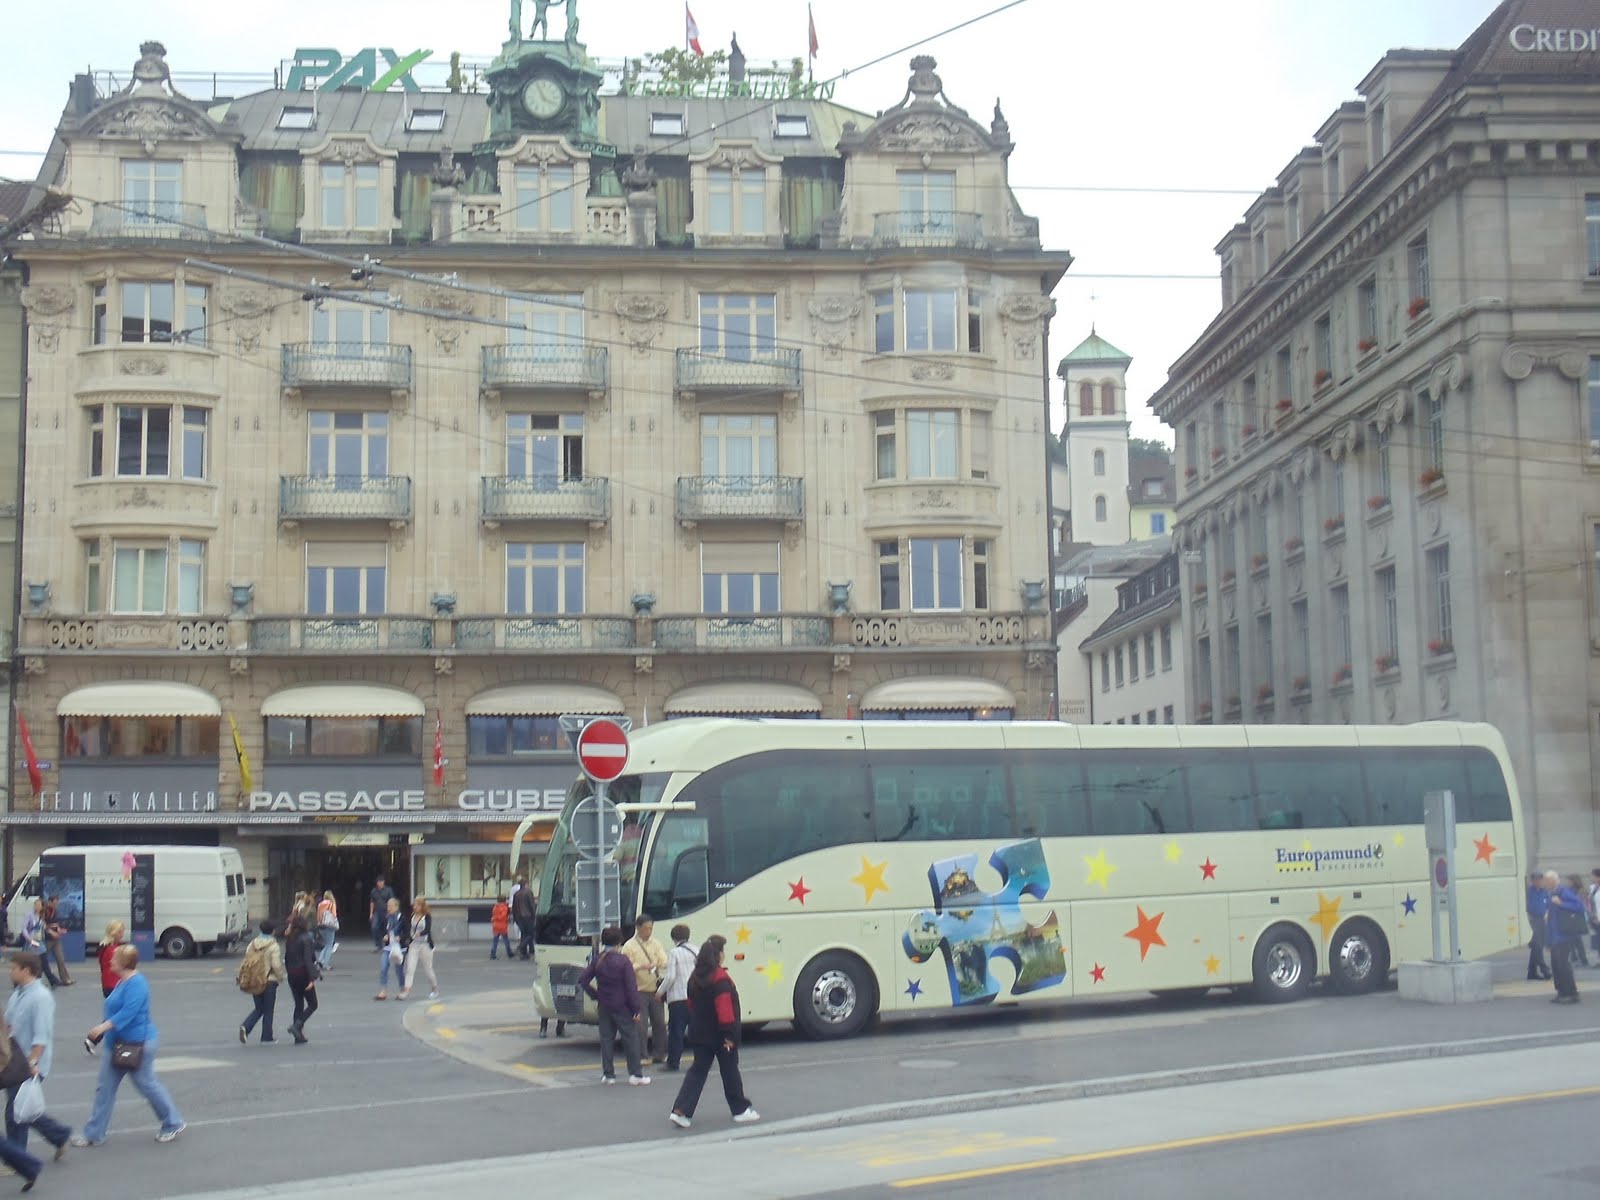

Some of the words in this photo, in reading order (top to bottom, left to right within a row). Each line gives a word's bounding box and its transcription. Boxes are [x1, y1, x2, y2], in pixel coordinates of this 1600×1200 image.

[1508, 23, 1600, 53] CREDI
[284, 47, 434, 92] PAX
[623, 79, 836, 101] VERSICHERUNGEN
[40, 791, 92, 811] FEIN
[131, 791, 216, 811] KALLER
[249, 790, 425, 811] PASSAGE
